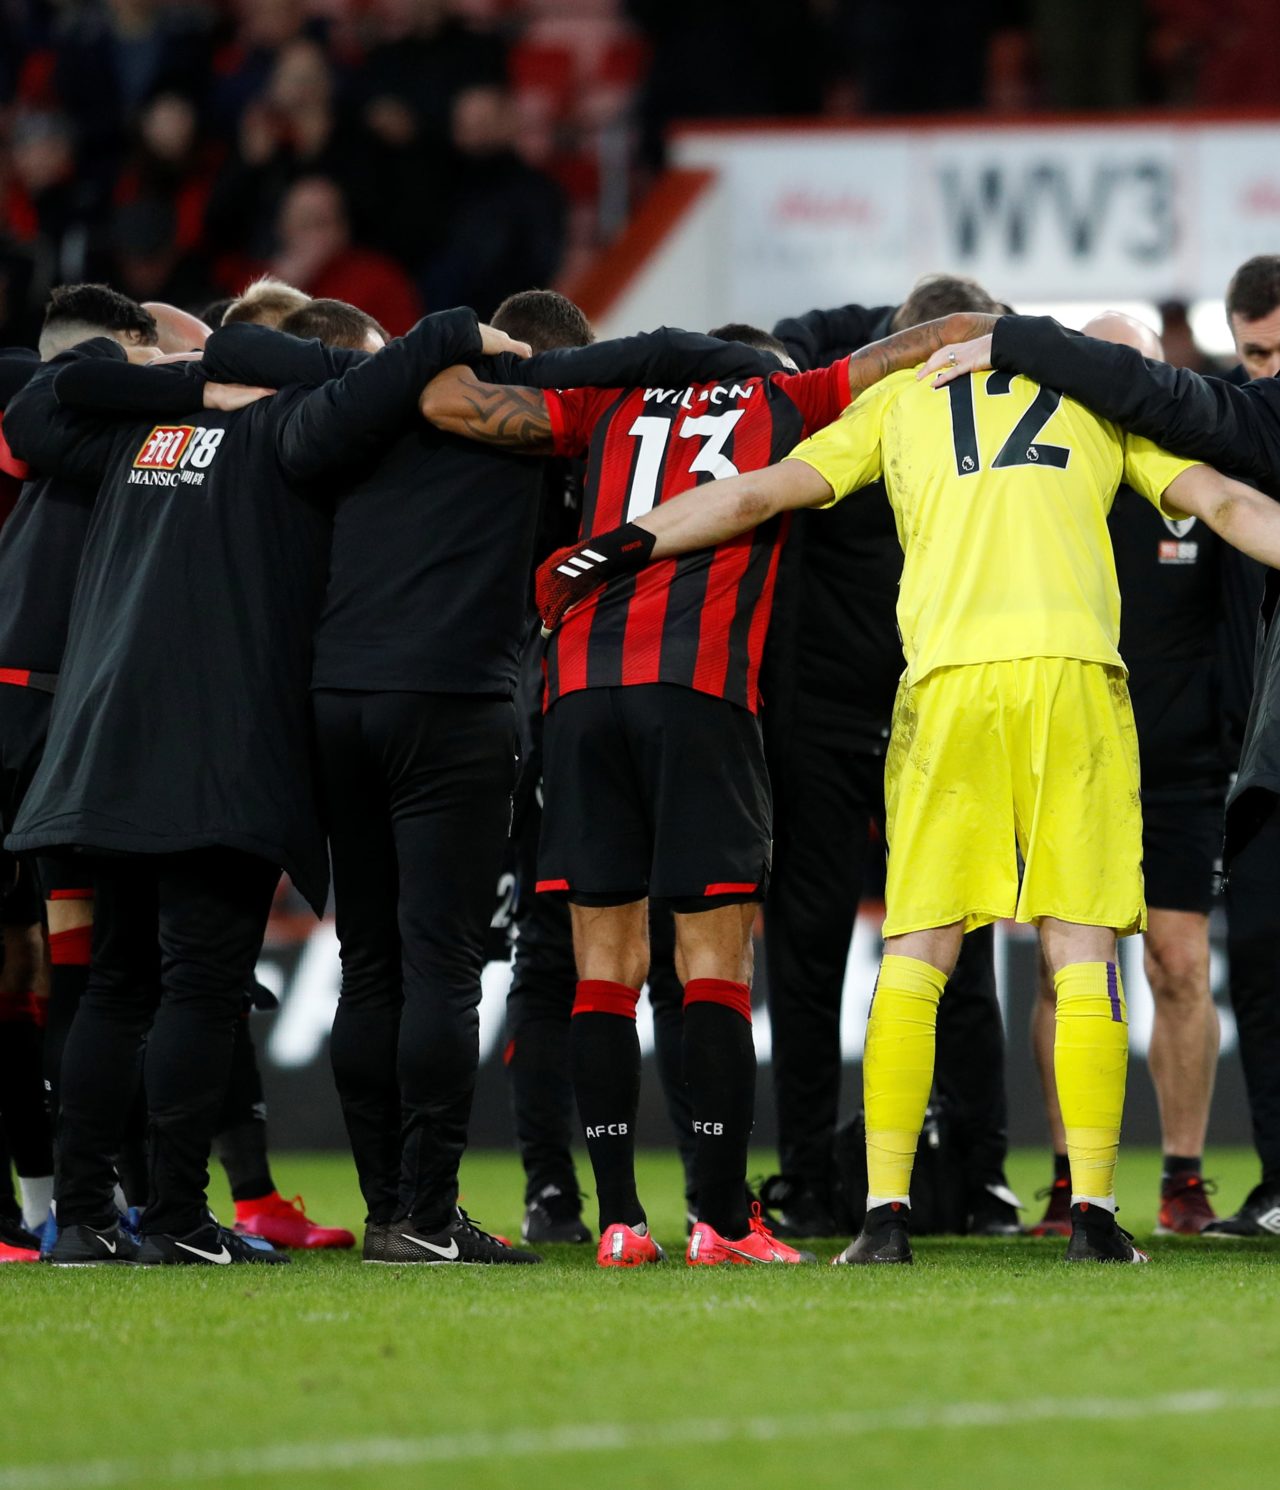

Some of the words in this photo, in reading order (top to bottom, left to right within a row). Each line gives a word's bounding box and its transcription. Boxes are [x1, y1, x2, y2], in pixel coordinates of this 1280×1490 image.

[938, 155, 1181, 264] WV3
[626, 409, 746, 524] 13
[933, 370, 1071, 477] 12
[586, 1123, 628, 1138] AFCB
[693, 1120, 723, 1135] FCB
